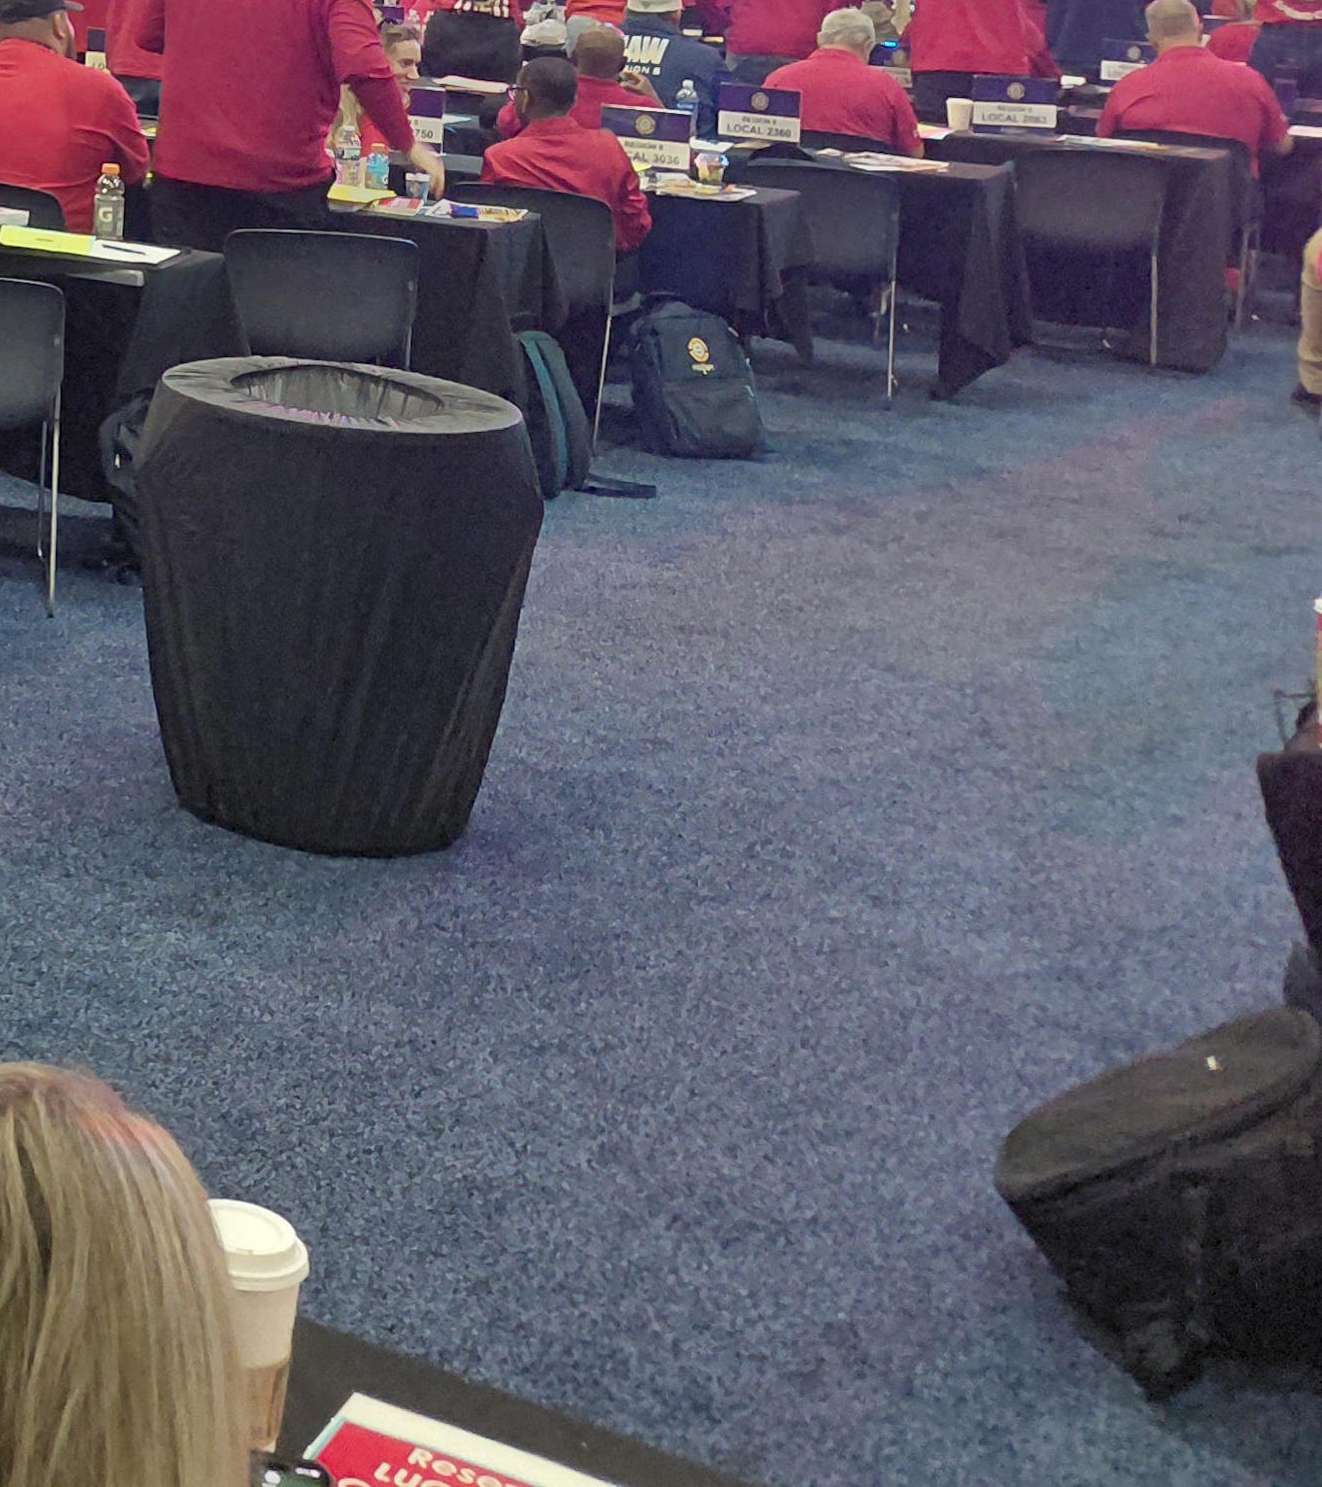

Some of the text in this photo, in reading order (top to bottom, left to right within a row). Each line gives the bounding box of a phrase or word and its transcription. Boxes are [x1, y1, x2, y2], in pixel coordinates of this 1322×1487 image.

[982, 114, 1017, 124] LOCAL
[414, 129, 434, 140] 750
[727, 123, 765, 135] LOCAL
[626, 151, 649, 163] CAL
[99, 207, 113, 222] G
